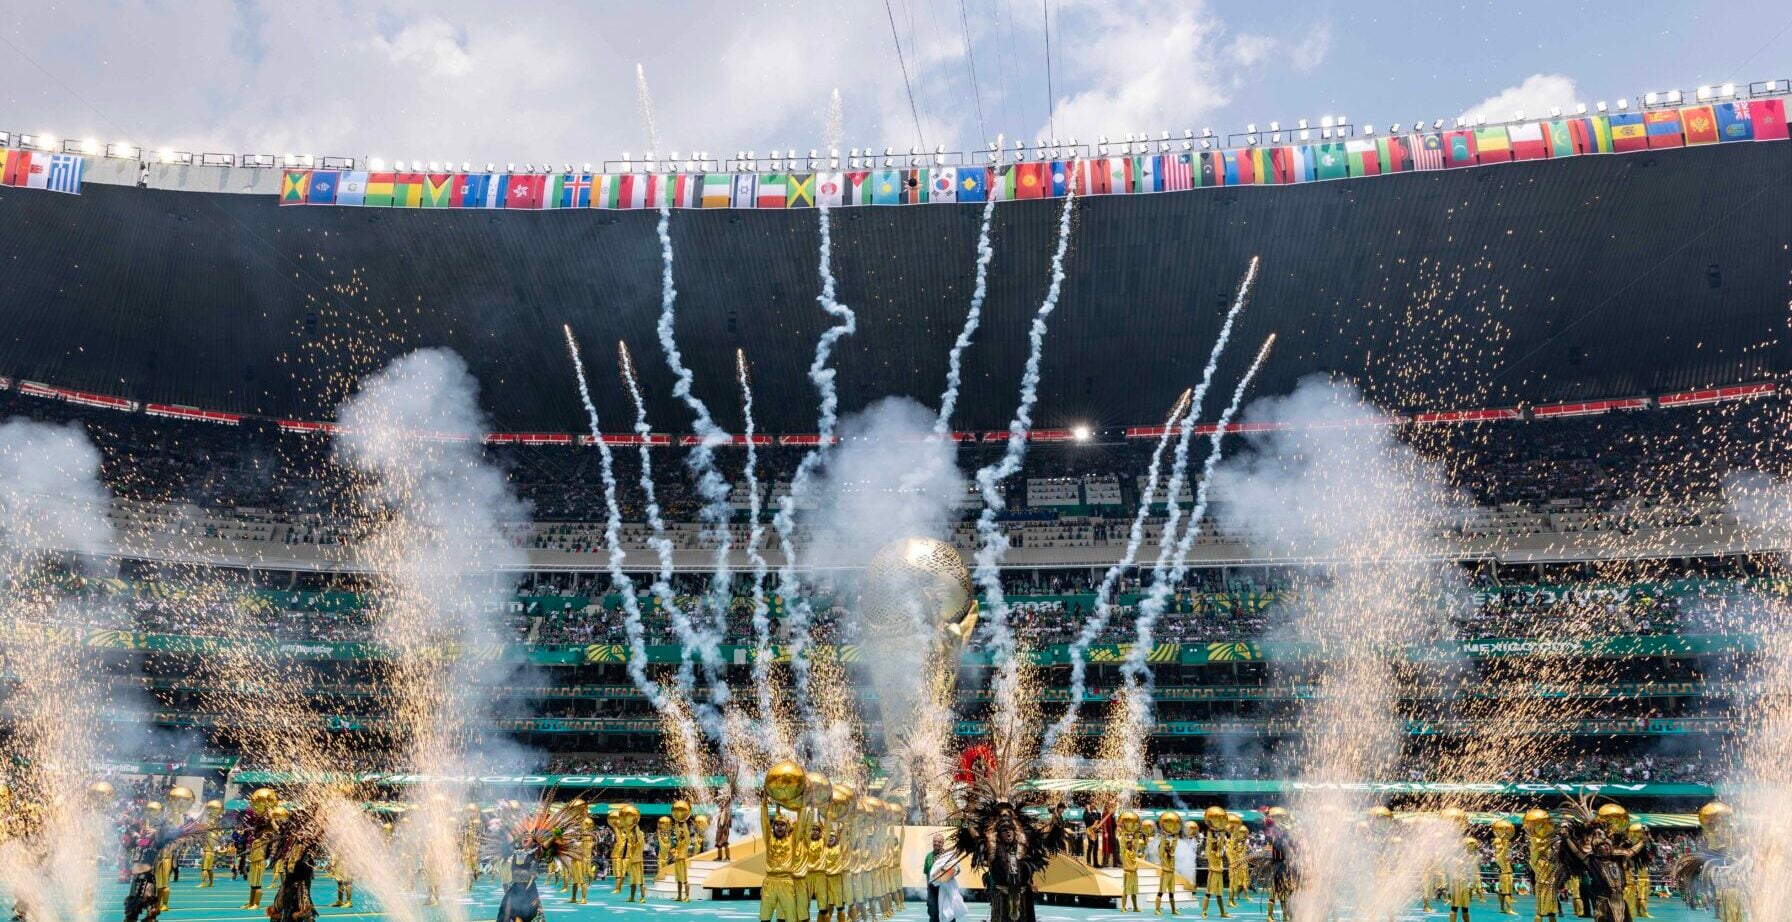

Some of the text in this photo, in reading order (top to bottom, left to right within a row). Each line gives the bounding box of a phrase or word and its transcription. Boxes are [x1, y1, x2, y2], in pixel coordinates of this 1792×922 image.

[1445, 589, 1630, 605] MEXCO CTY
[1463, 643, 1533, 653] MEXICO
[1165, 688, 1265, 698] FIFA FIFA
[559, 776, 670, 784] CITY
[1293, 783, 1647, 791] MEXICO CITY
